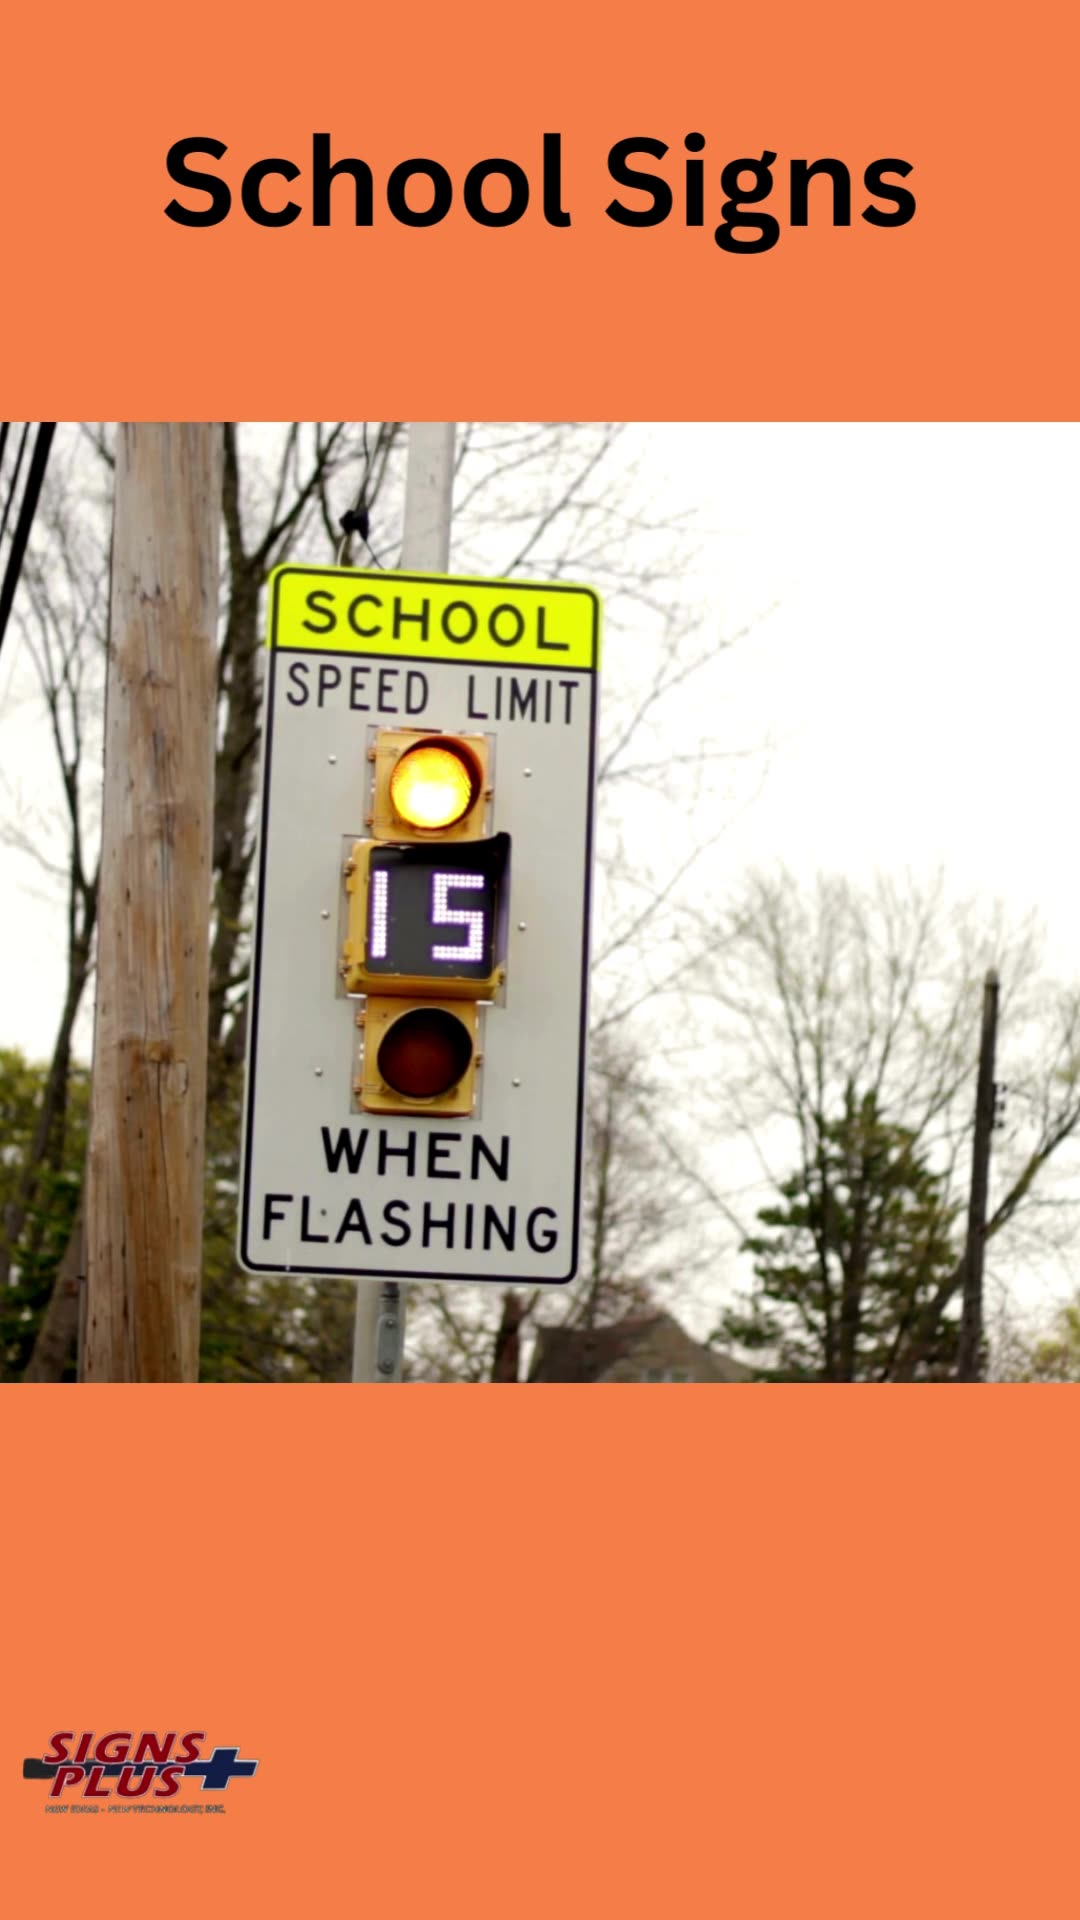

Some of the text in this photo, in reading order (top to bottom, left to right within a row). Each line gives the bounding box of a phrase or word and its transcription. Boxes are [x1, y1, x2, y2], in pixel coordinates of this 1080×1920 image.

[301, 589, 570, 652] SCHOOL
[286, 661, 579, 725] SPEED LIMIT
[370, 869, 485, 962] 15
[320, 1126, 510, 1182] WHEN
[262, 1193, 559, 1254] FLASHING
